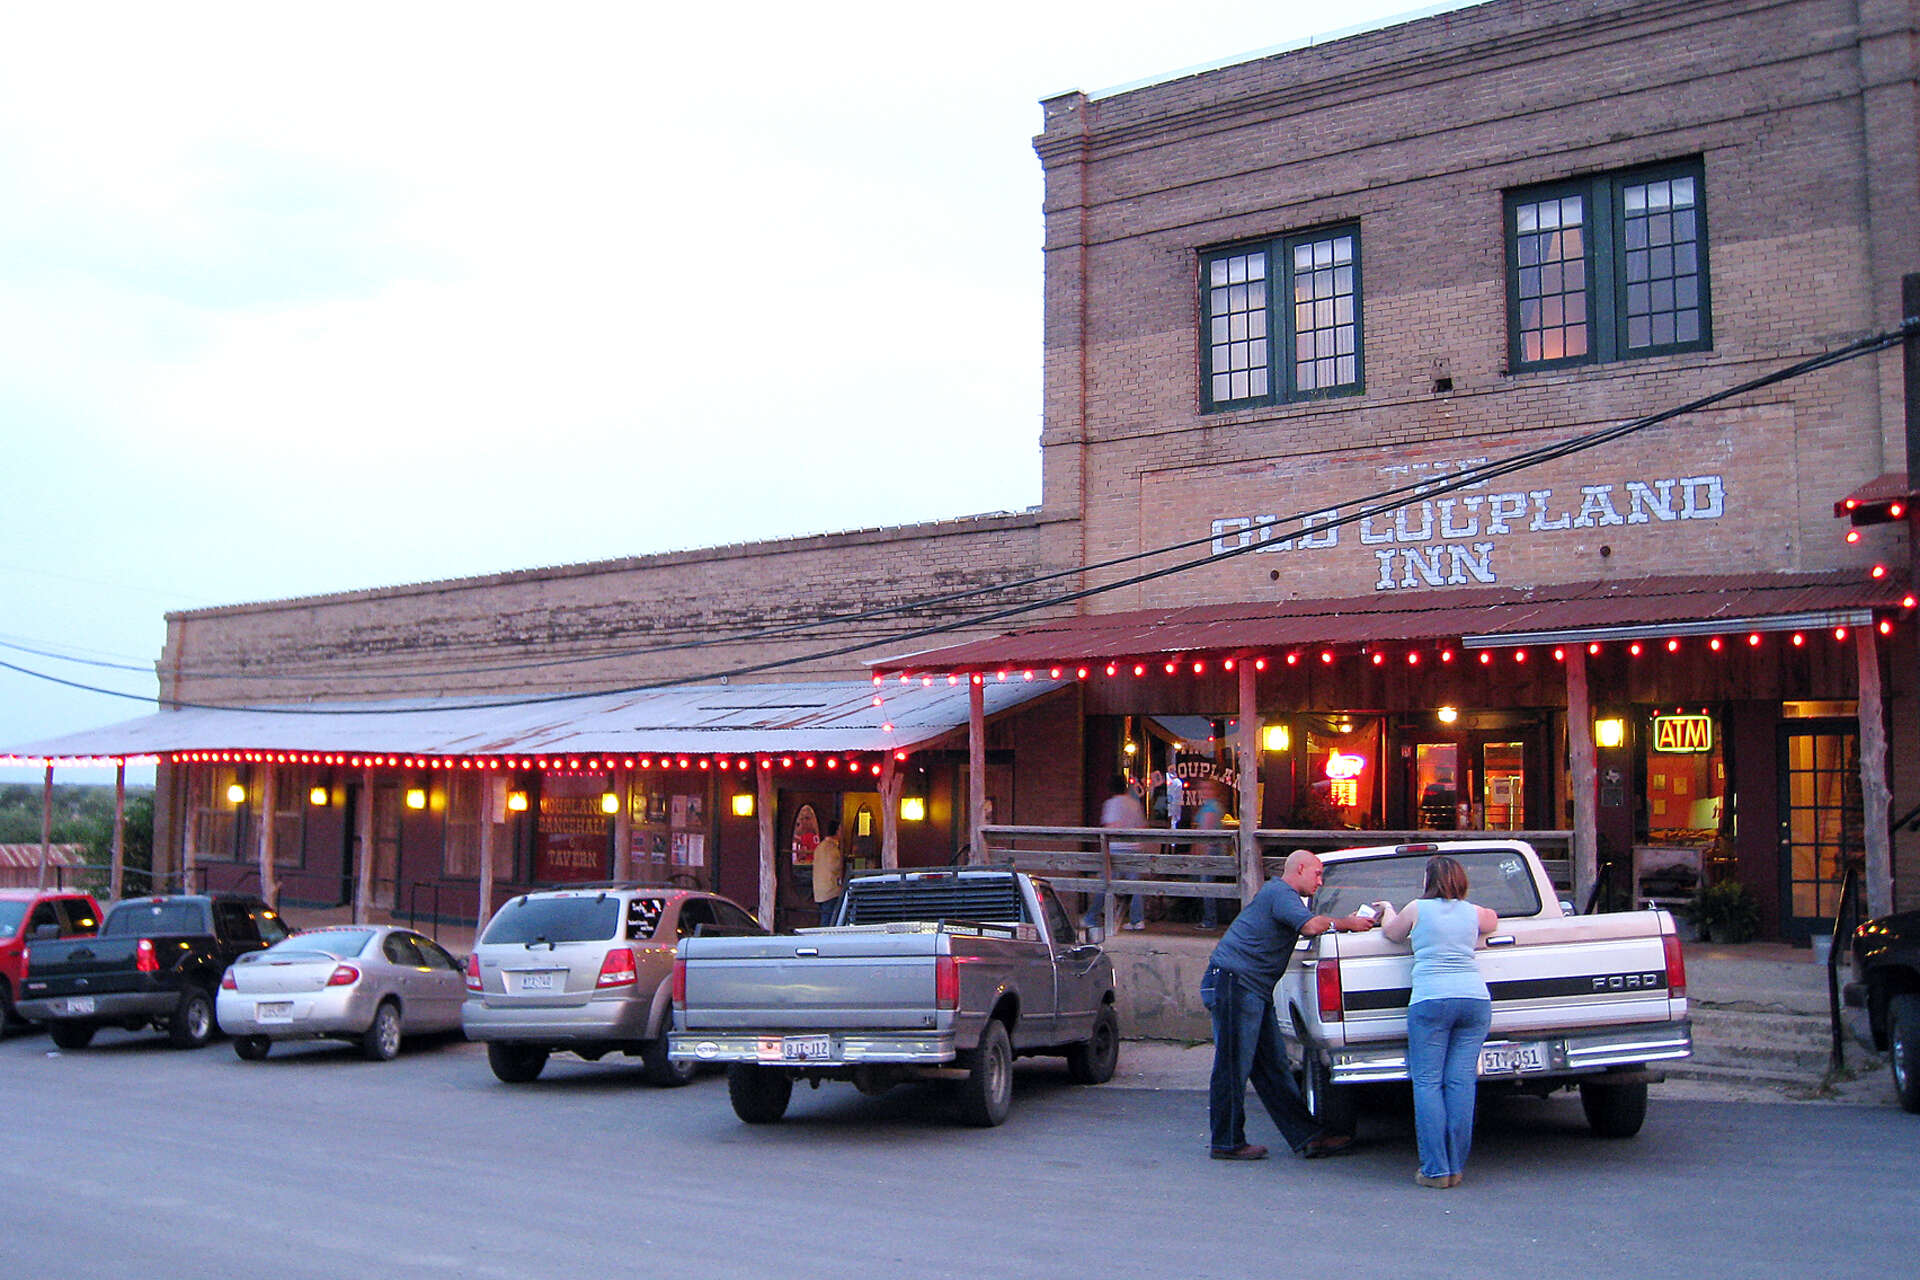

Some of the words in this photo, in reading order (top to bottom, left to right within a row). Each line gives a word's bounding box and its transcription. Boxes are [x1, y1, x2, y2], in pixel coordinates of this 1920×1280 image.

[1211, 508, 1340, 556] OLD
[1358, 474, 1728, 546] COUPLAND
[1375, 541, 1497, 591] INN
[1659, 718, 1708, 748] ATM
[538, 815, 608, 836] DANCEHALL
[546, 849, 598, 868] TAVERN
[1592, 973, 1658, 990] FORD
